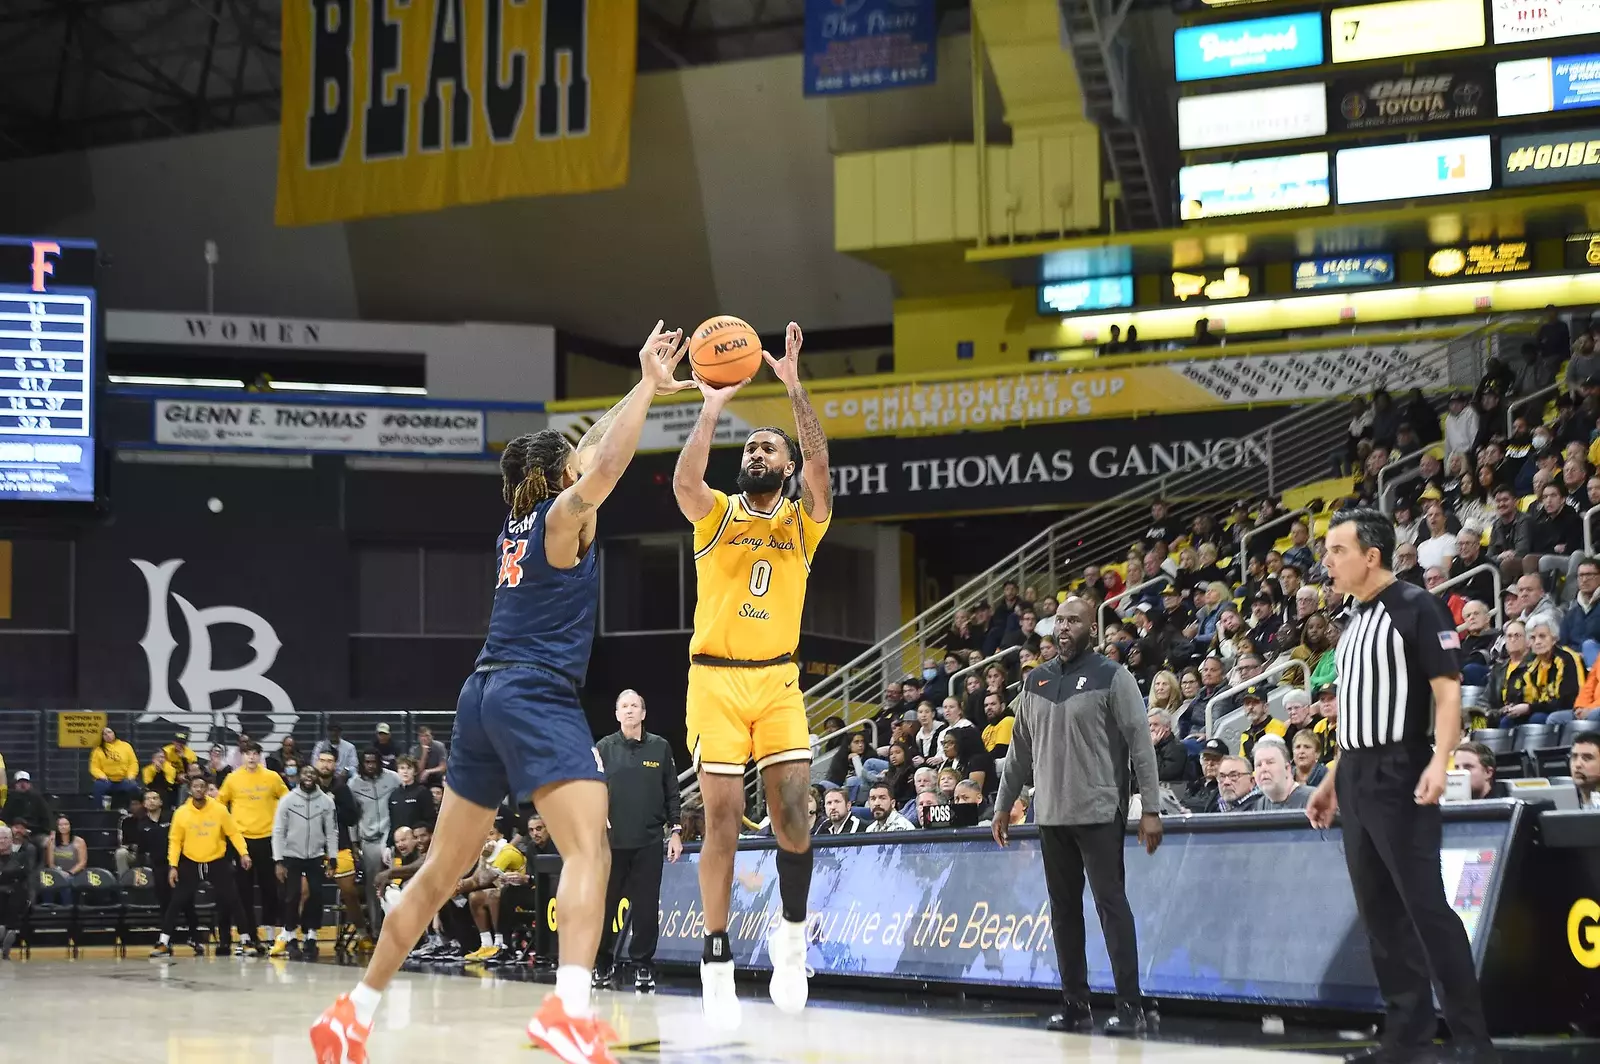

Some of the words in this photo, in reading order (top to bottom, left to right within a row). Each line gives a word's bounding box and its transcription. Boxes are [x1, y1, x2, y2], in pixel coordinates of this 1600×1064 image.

[304, 0, 591, 169] BEACH
[1375, 92, 1445, 116] TOYOTA
[31, 241, 60, 292] F
[186, 319, 321, 343] WOMEN
[713, 337, 748, 355] NCAA
[824, 382, 1059, 418] COMMISSIONER'S
[1072, 378, 1125, 398] CUP
[164, 405, 241, 425] GLENN
[248, 407, 266, 426] E.
[273, 409, 367, 429] THOMAS
[381, 414, 478, 430] #GOBEACH
[865, 399, 1092, 431] CHAMPIONSHIPS
[902, 450, 1073, 491] THOMAS
[1088, 437, 1269, 479] GANNON
[729, 533, 763, 551] Long
[766, 535, 795, 550] Bach
[749, 559, 772, 597] 0
[739, 603, 769, 620] State
[930, 805, 950, 822] POSS
[662, 900, 681, 937] is
[837, 901, 880, 945] live
[882, 904, 914, 946] at
[913, 900, 957, 948] the
